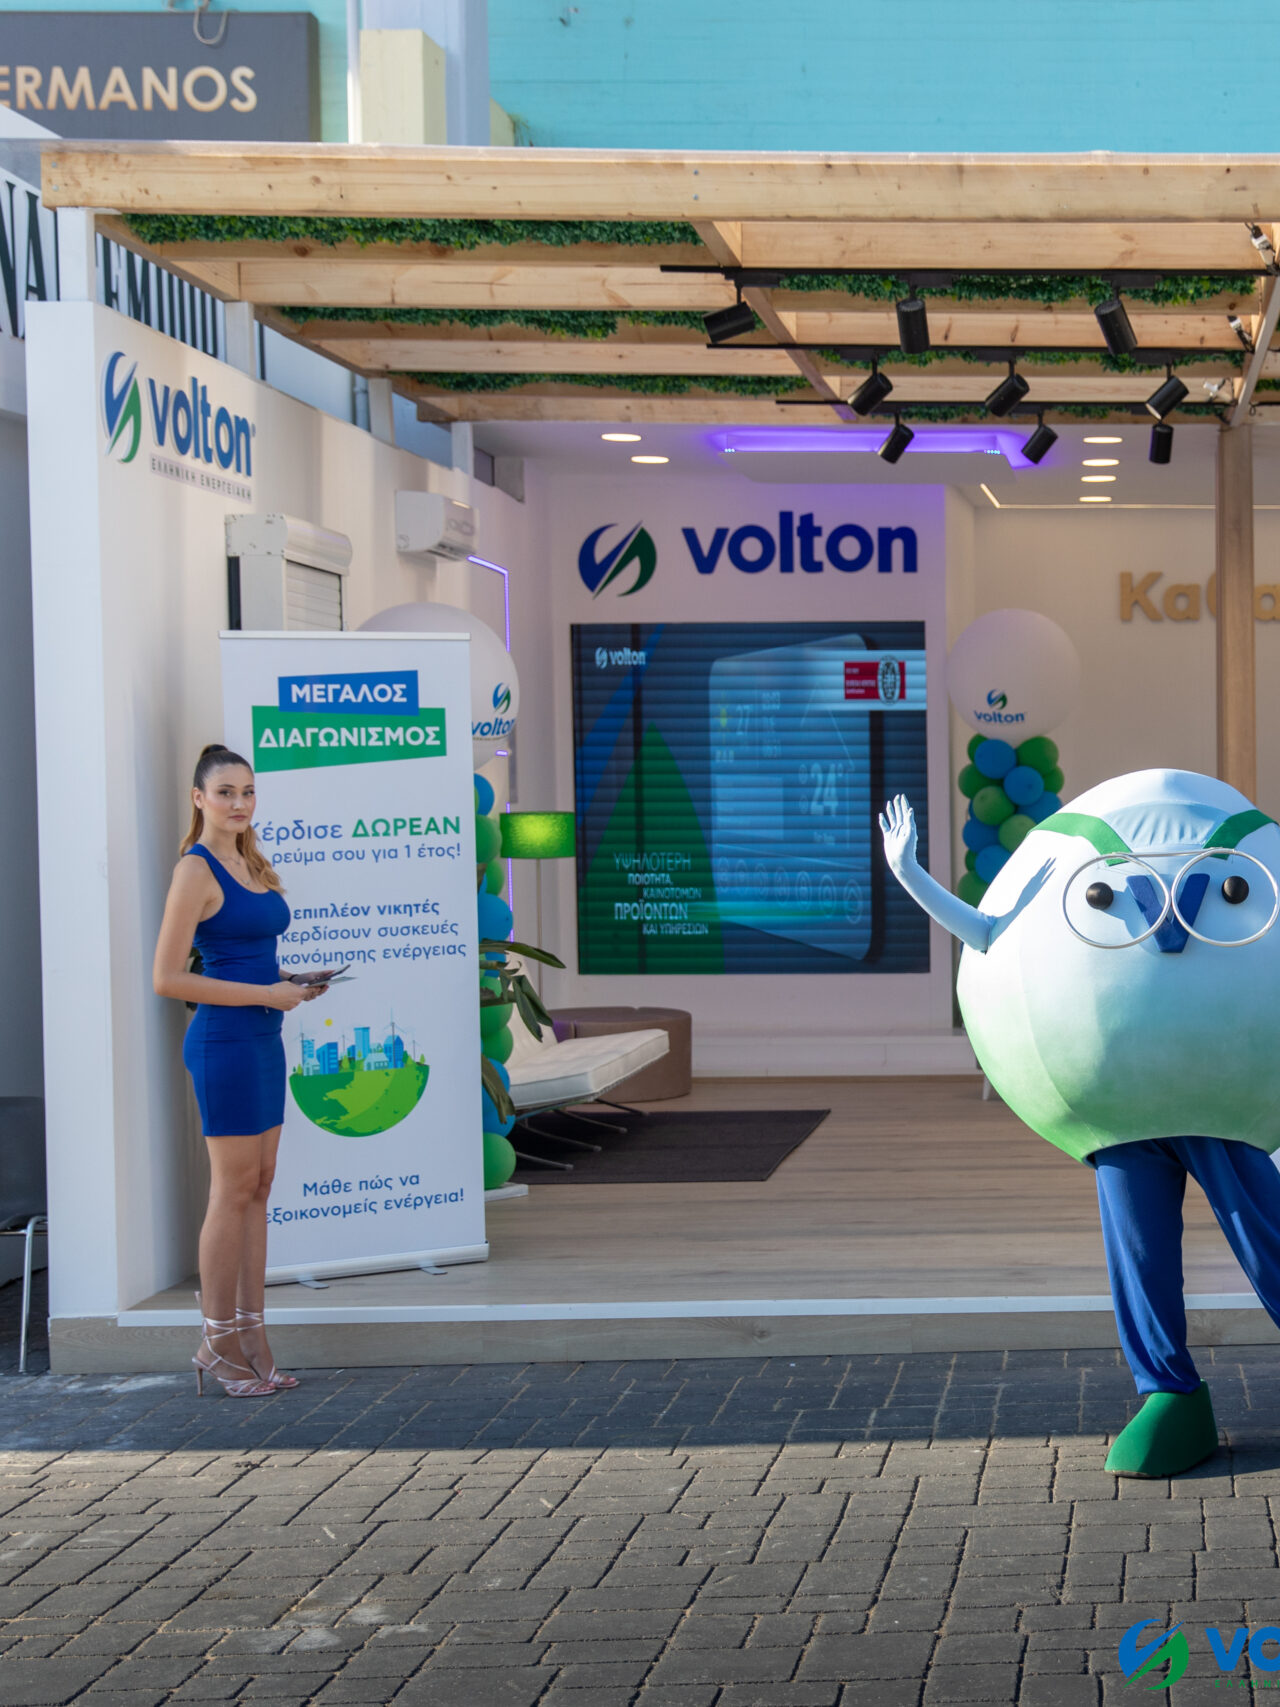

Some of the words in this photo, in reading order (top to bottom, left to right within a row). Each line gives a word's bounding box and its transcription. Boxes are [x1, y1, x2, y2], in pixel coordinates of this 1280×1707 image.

[681, 510, 918, 574] volton
[609, 647, 646, 666] volton
[291, 683, 407, 704] ΜΕΓΑΛΟΣ
[973, 710, 1025, 724] volton
[258, 726, 441, 749] ΔΙΑΓΩΝΙΣΜΟΣ
[352, 816, 460, 838] ΔΩΡΕΑΝ
[272, 848, 325, 867] ρεύμα
[332, 850, 365, 862] σου
[372, 847, 398, 863] για
[404, 844, 411, 858] 1
[417, 843, 461, 860] έτος!
[293, 902, 371, 920] επιπλέον
[377, 899, 440, 916] νικητές
[281, 925, 371, 945] κερδίσουν
[378, 919, 459, 938] συσκευές
[382, 943, 467, 961] ενέργειας
[303, 1178, 353, 1197] Μάθε
[358, 1174, 394, 1193] πώς
[399, 1174, 420, 1187] να
[265, 1198, 377, 1225] εξοικονομείς
[384, 1188, 464, 1212] ενέργεια!
